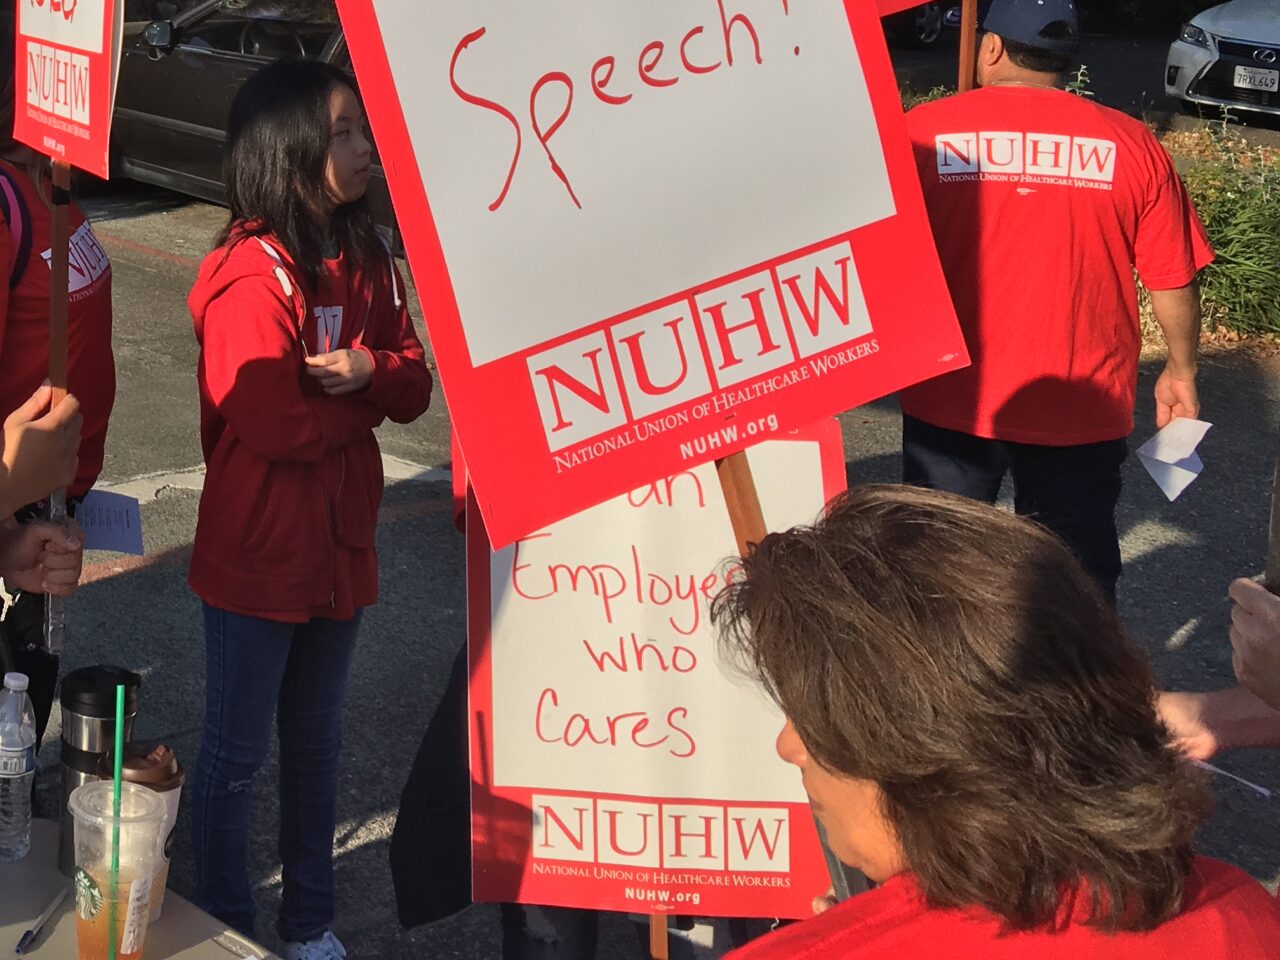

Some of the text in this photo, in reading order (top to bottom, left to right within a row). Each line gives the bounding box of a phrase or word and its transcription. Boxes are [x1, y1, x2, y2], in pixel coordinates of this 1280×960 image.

[28, 51, 89, 113] NUHW
[939, 138, 1112, 172] NUHW
[939, 174, 980, 183] NATIONAL
[979, 172, 1008, 182] UNION
[1073, 178, 1113, 190] WORKERS
[535, 255, 851, 434] NUHW
[552, 338, 879, 474] NATIONAL UNION OF HEALTHCARE WORKERS
[679, 412, 779, 460] NUHW.org
[535, 688, 696, 758] Cares
[538, 805, 786, 861] NUHW
[532, 863, 791, 888] NATIONAL UNION OF HEALTHCARE WORKERS
[625, 888, 700, 905] NUHW.org
